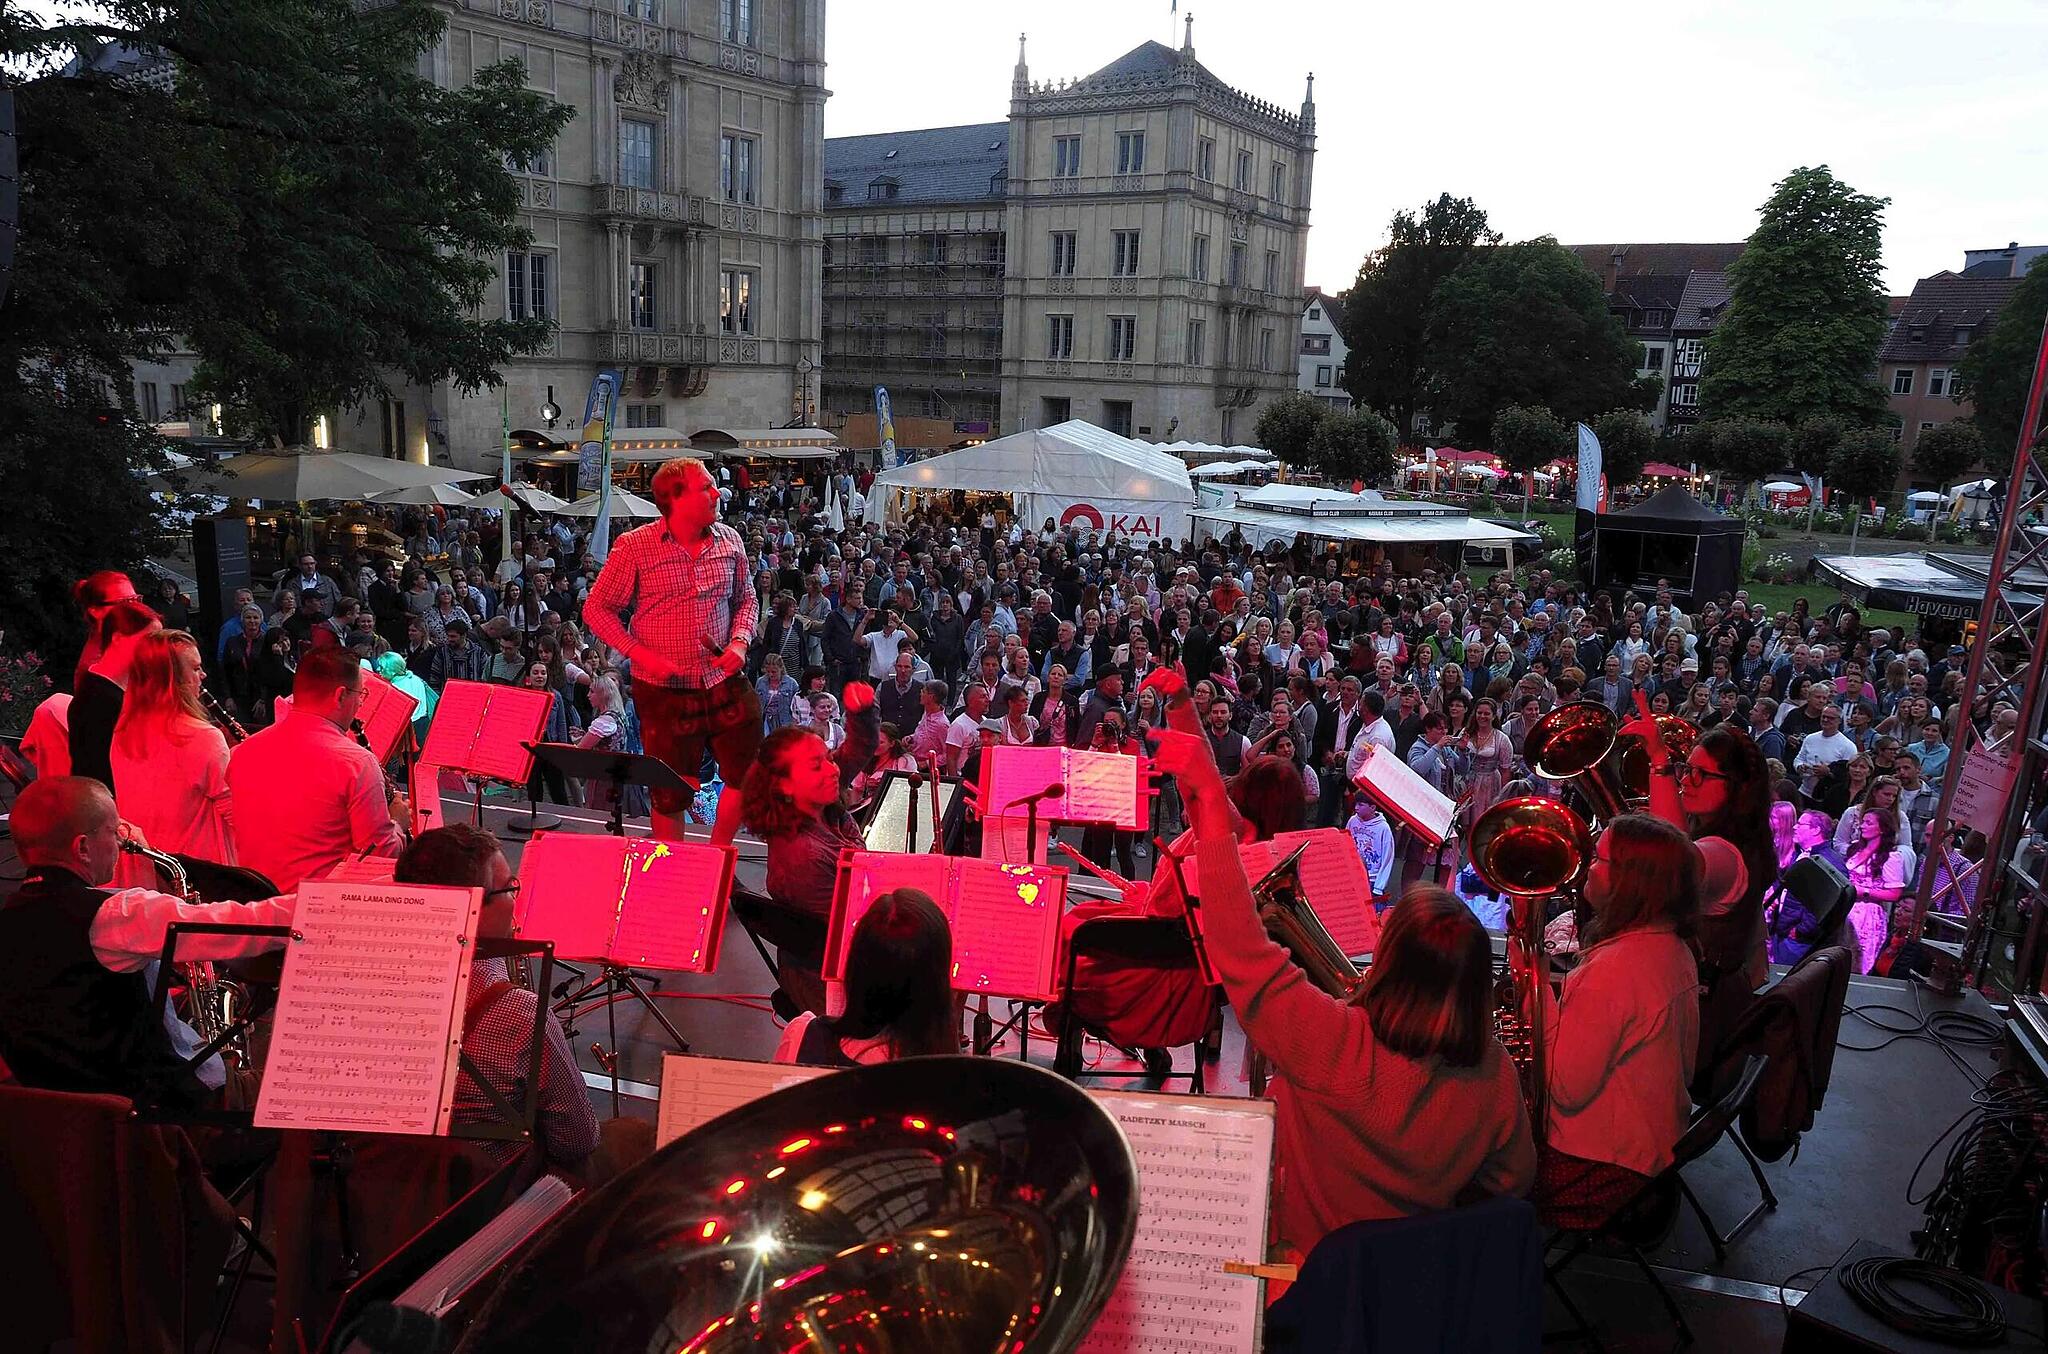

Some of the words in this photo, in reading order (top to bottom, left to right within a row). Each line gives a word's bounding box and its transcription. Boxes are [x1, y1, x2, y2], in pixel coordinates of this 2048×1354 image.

[1904, 595, 1974, 620] Havana
[340, 893, 362, 902] RAMA
[363, 895, 384, 903] LAMA
[384, 896, 402, 904] DING
[403, 897, 425, 906] DONG
[1119, 1114, 1167, 1126] RADETZKY
[1168, 1120, 1206, 1129] MARSCH
